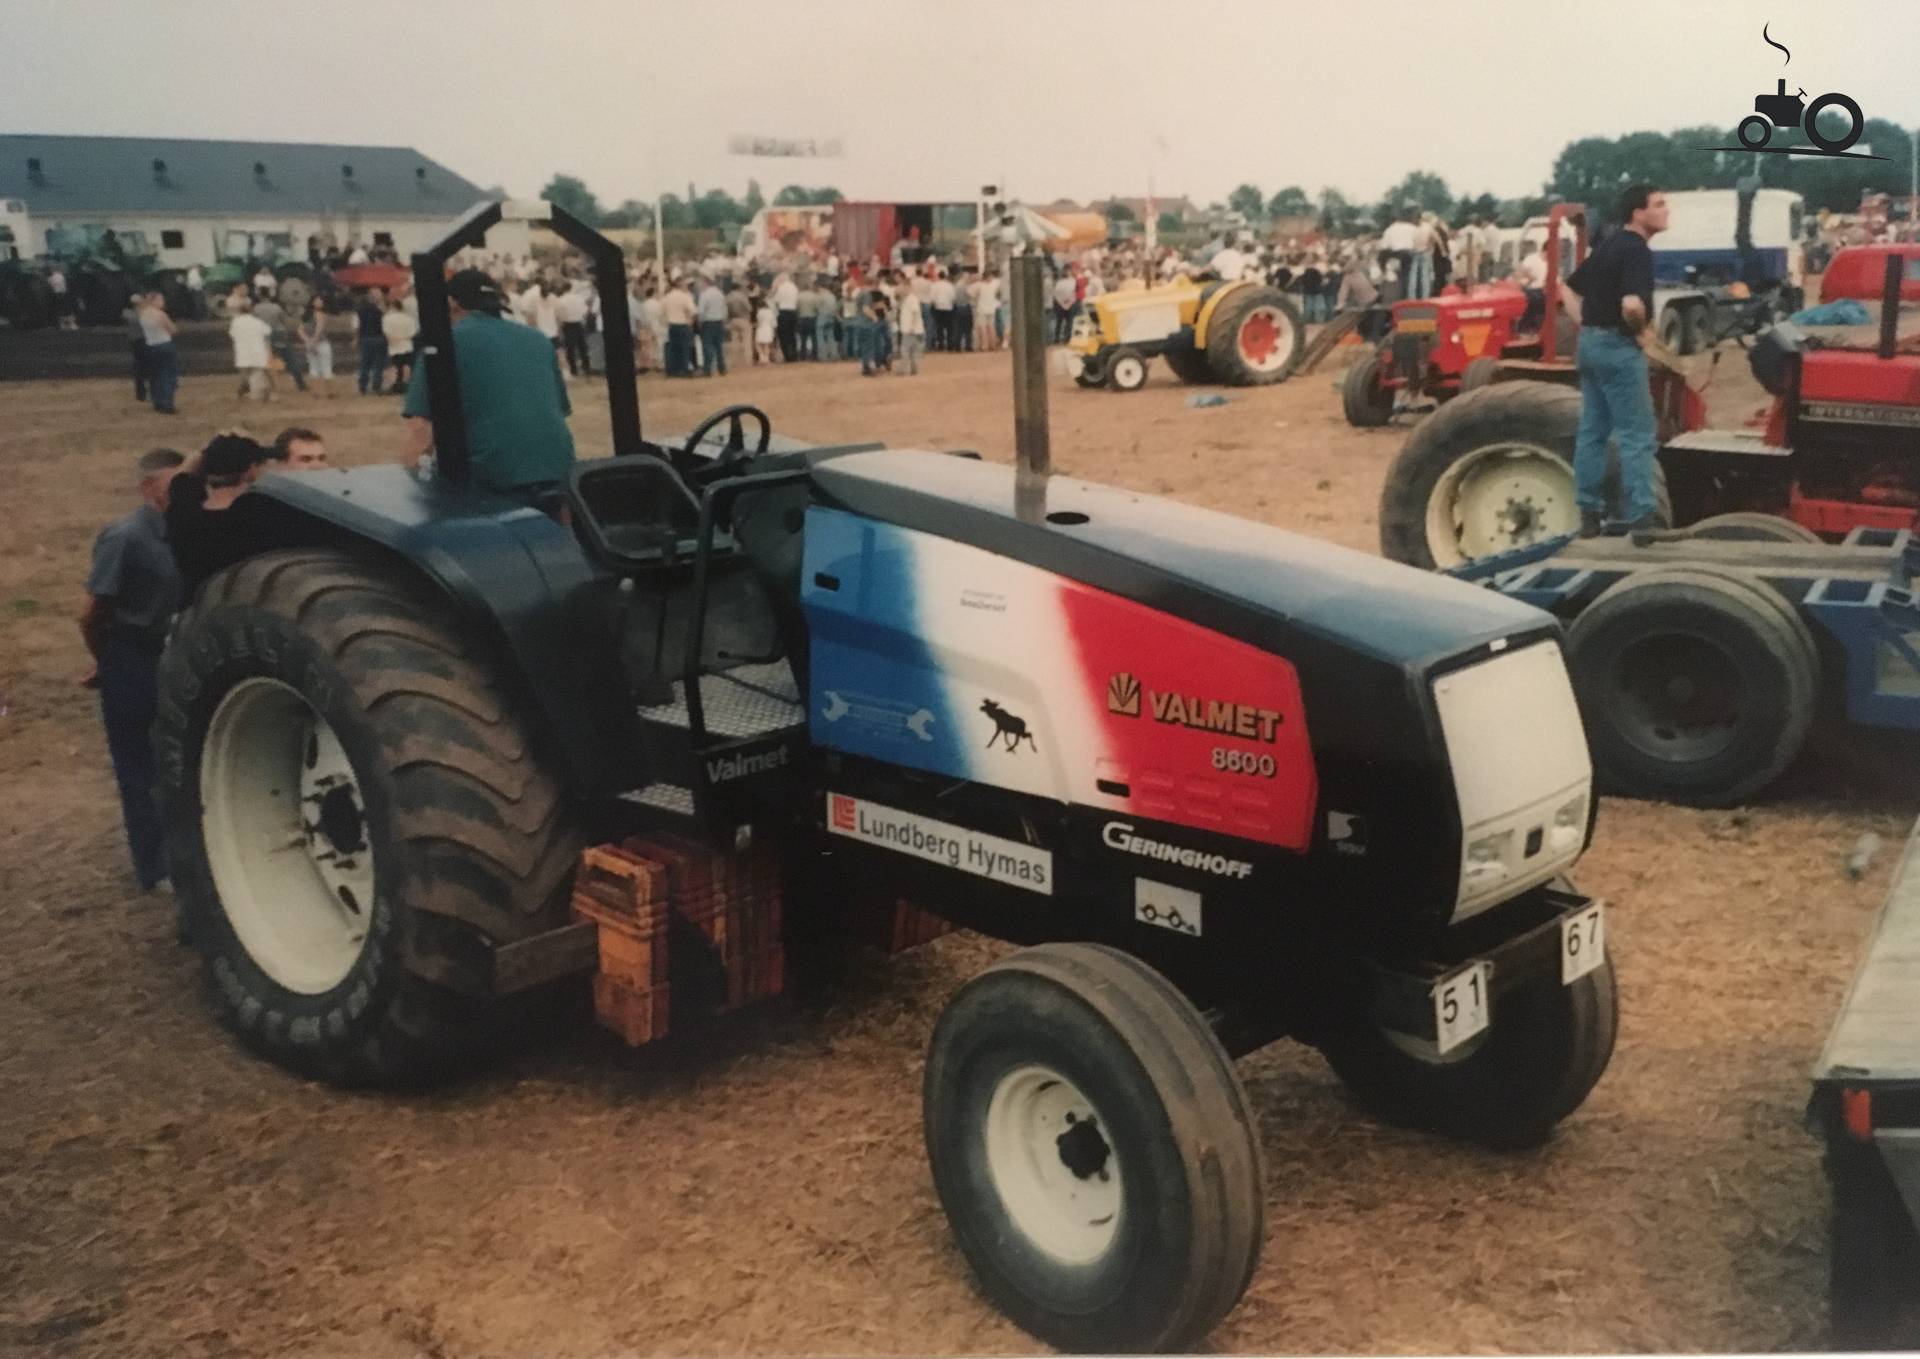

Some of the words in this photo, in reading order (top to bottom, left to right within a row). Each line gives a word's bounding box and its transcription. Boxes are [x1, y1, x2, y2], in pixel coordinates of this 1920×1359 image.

[1150, 689, 1283, 743] VALMET
[706, 744, 788, 783] Valmet
[1212, 747, 1276, 778] 8600
[858, 810, 961, 866] Lundberg
[967, 838, 1046, 884] Hymas
[1102, 821, 1254, 879] GERINGHOFF
[1567, 911, 1599, 956] 67
[1442, 973, 1480, 1024] 51
